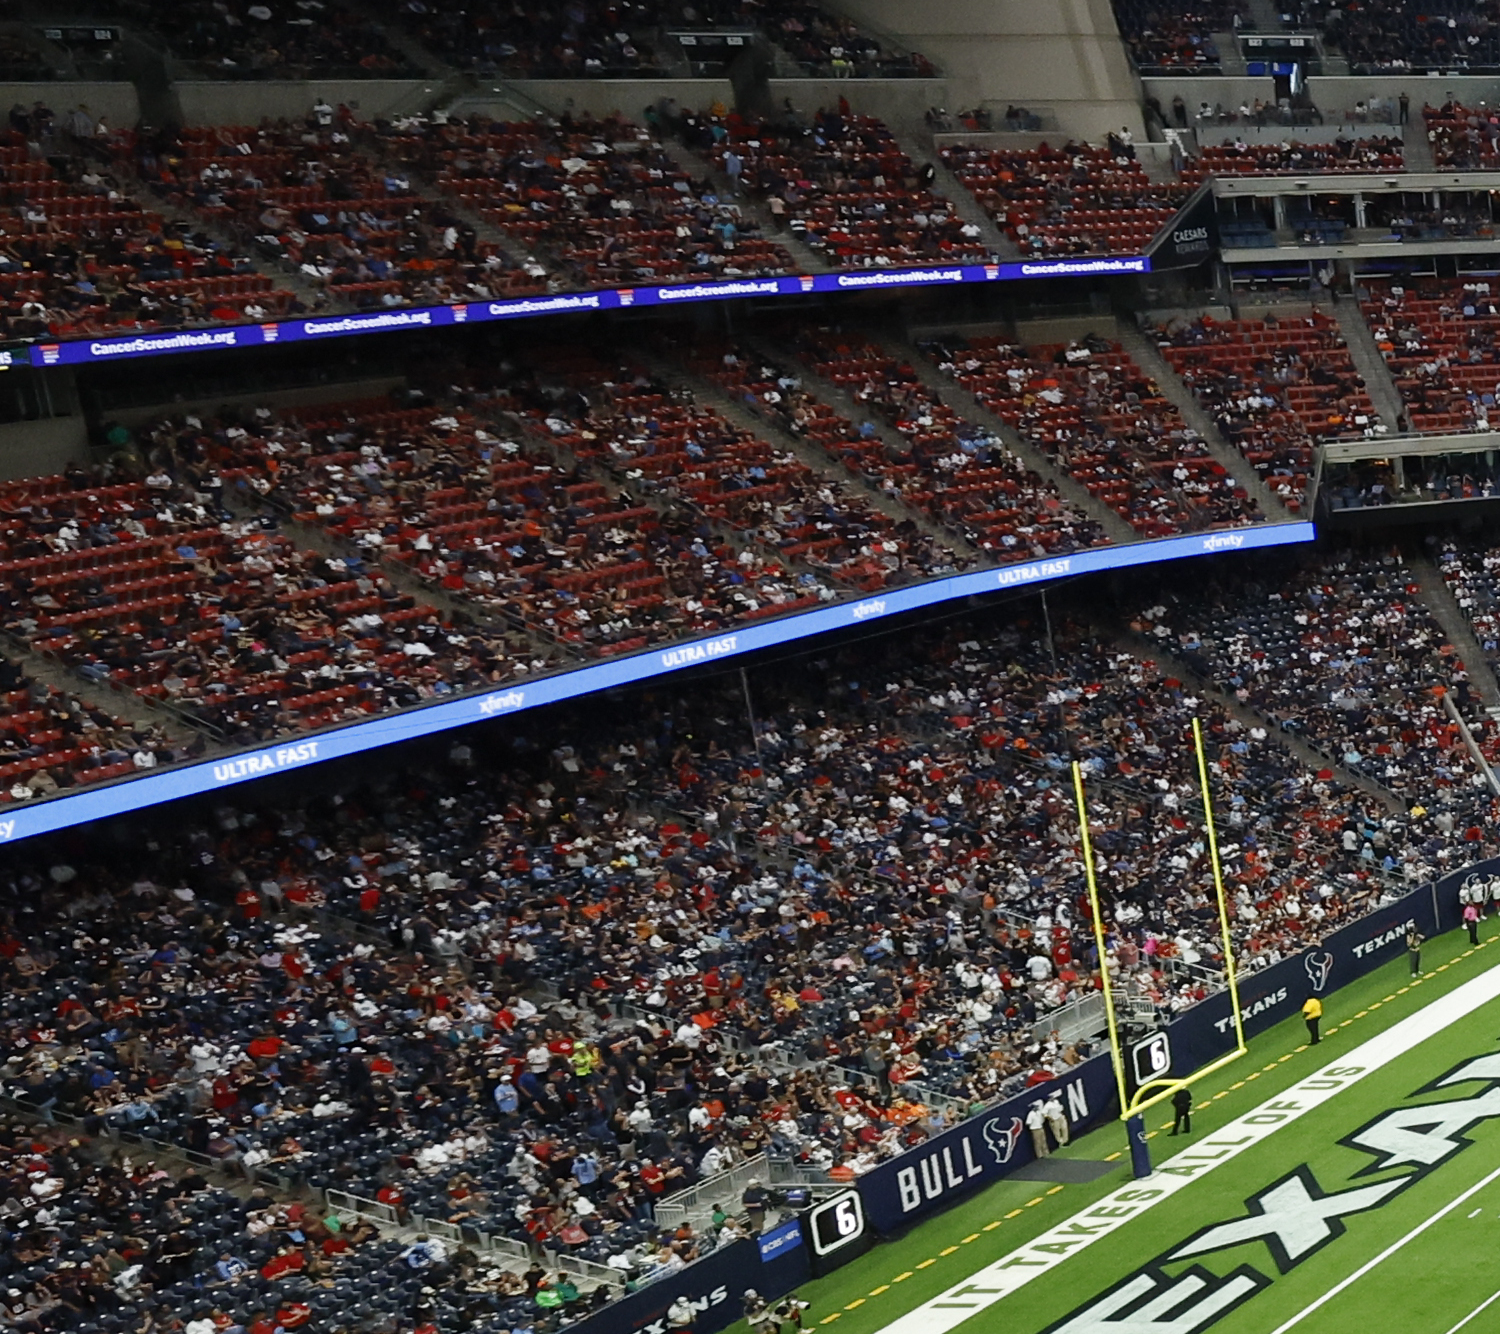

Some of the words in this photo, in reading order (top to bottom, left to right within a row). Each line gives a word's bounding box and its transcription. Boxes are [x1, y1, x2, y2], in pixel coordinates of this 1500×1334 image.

[304, 310, 432, 336] CancerScreenWeek.org
[91, 329, 237, 356] CancerScreenWeek.org
[479, 689, 525, 717] xfinity
[213, 751, 273, 782] ULTRA
[274, 740, 320, 772] FAST
[896, 1133, 984, 1213] BULL
[932, 1281, 1006, 1312] IT
[999, 1185, 1166, 1272] TAKES
[1163, 1130, 1256, 1179] ALL
[1245, 1095, 1310, 1126] OF
[1297, 1063, 1367, 1092] US
[834, 1204, 858, 1237] 6
